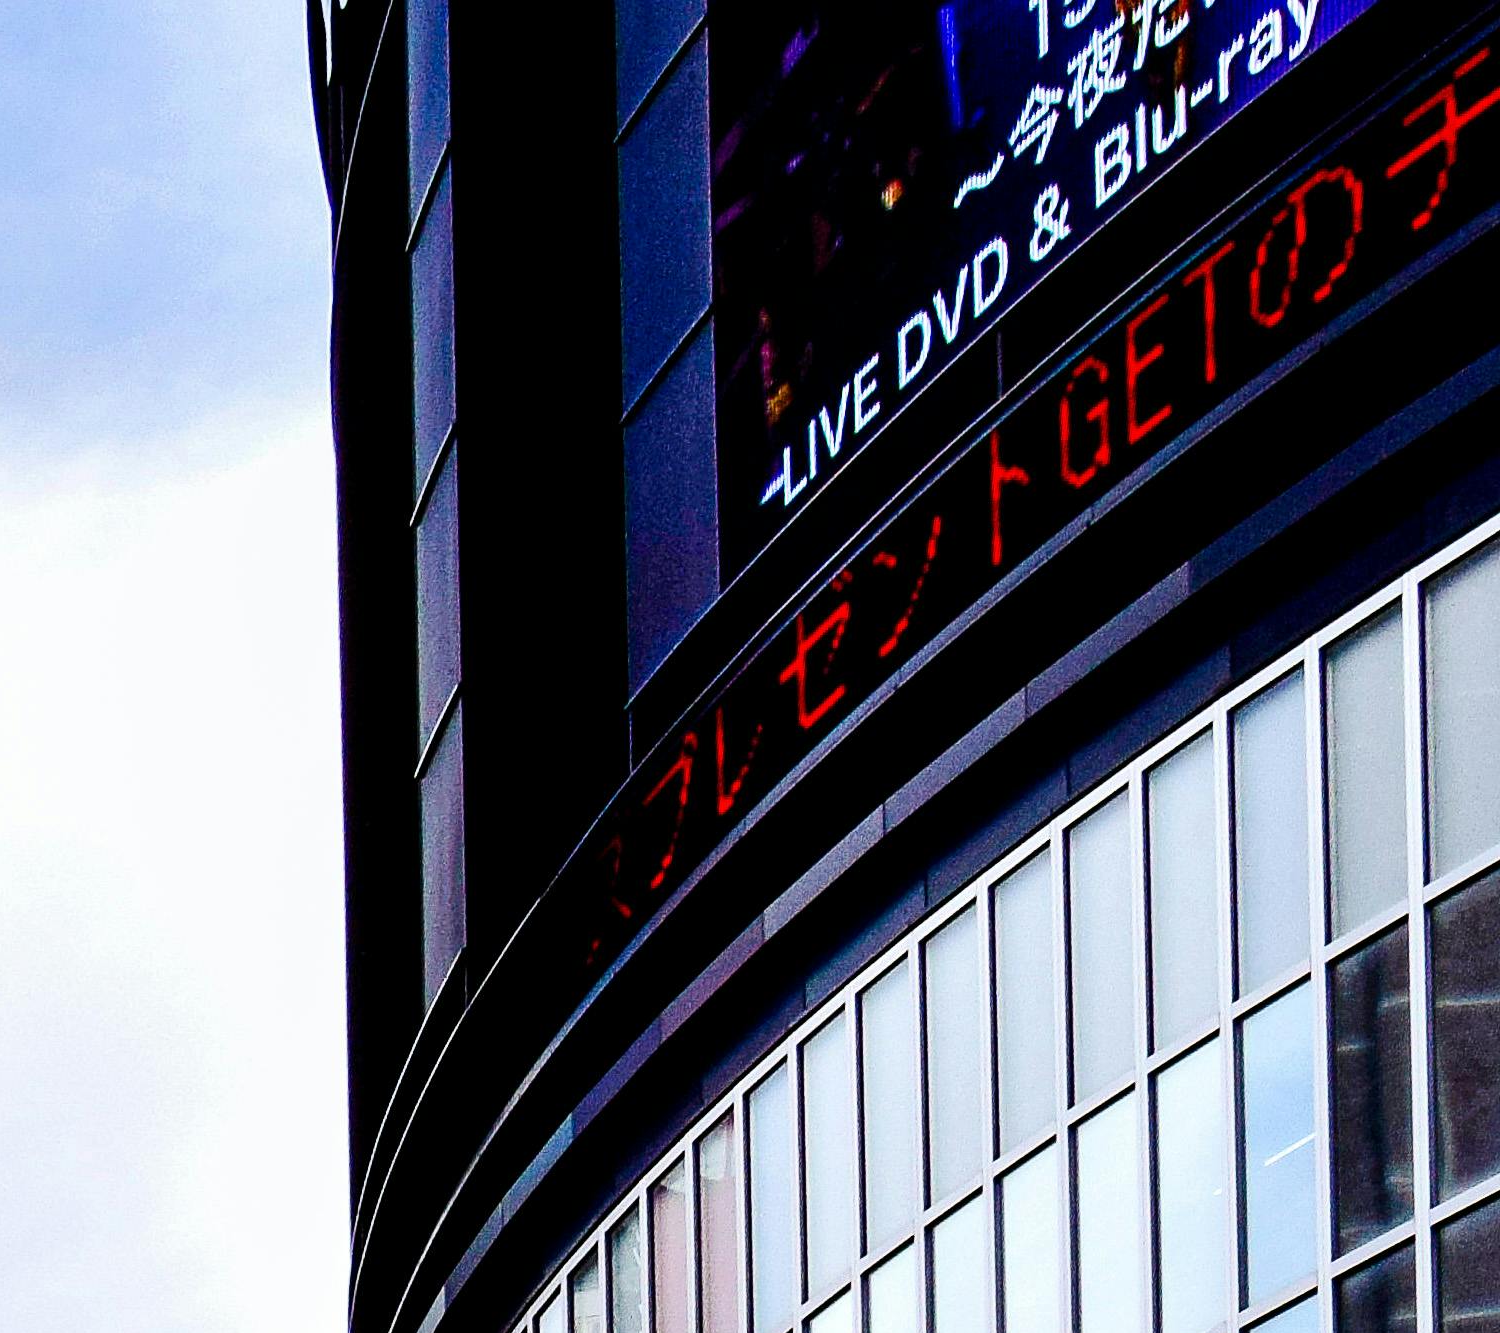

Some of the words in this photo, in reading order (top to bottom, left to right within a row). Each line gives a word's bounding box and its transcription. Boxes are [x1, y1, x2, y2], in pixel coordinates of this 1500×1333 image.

[899, 236, 1008, 390] DVD
[1029, 183, 1071, 261] &
[1095, 0, 1317, 208] Blu-ray
